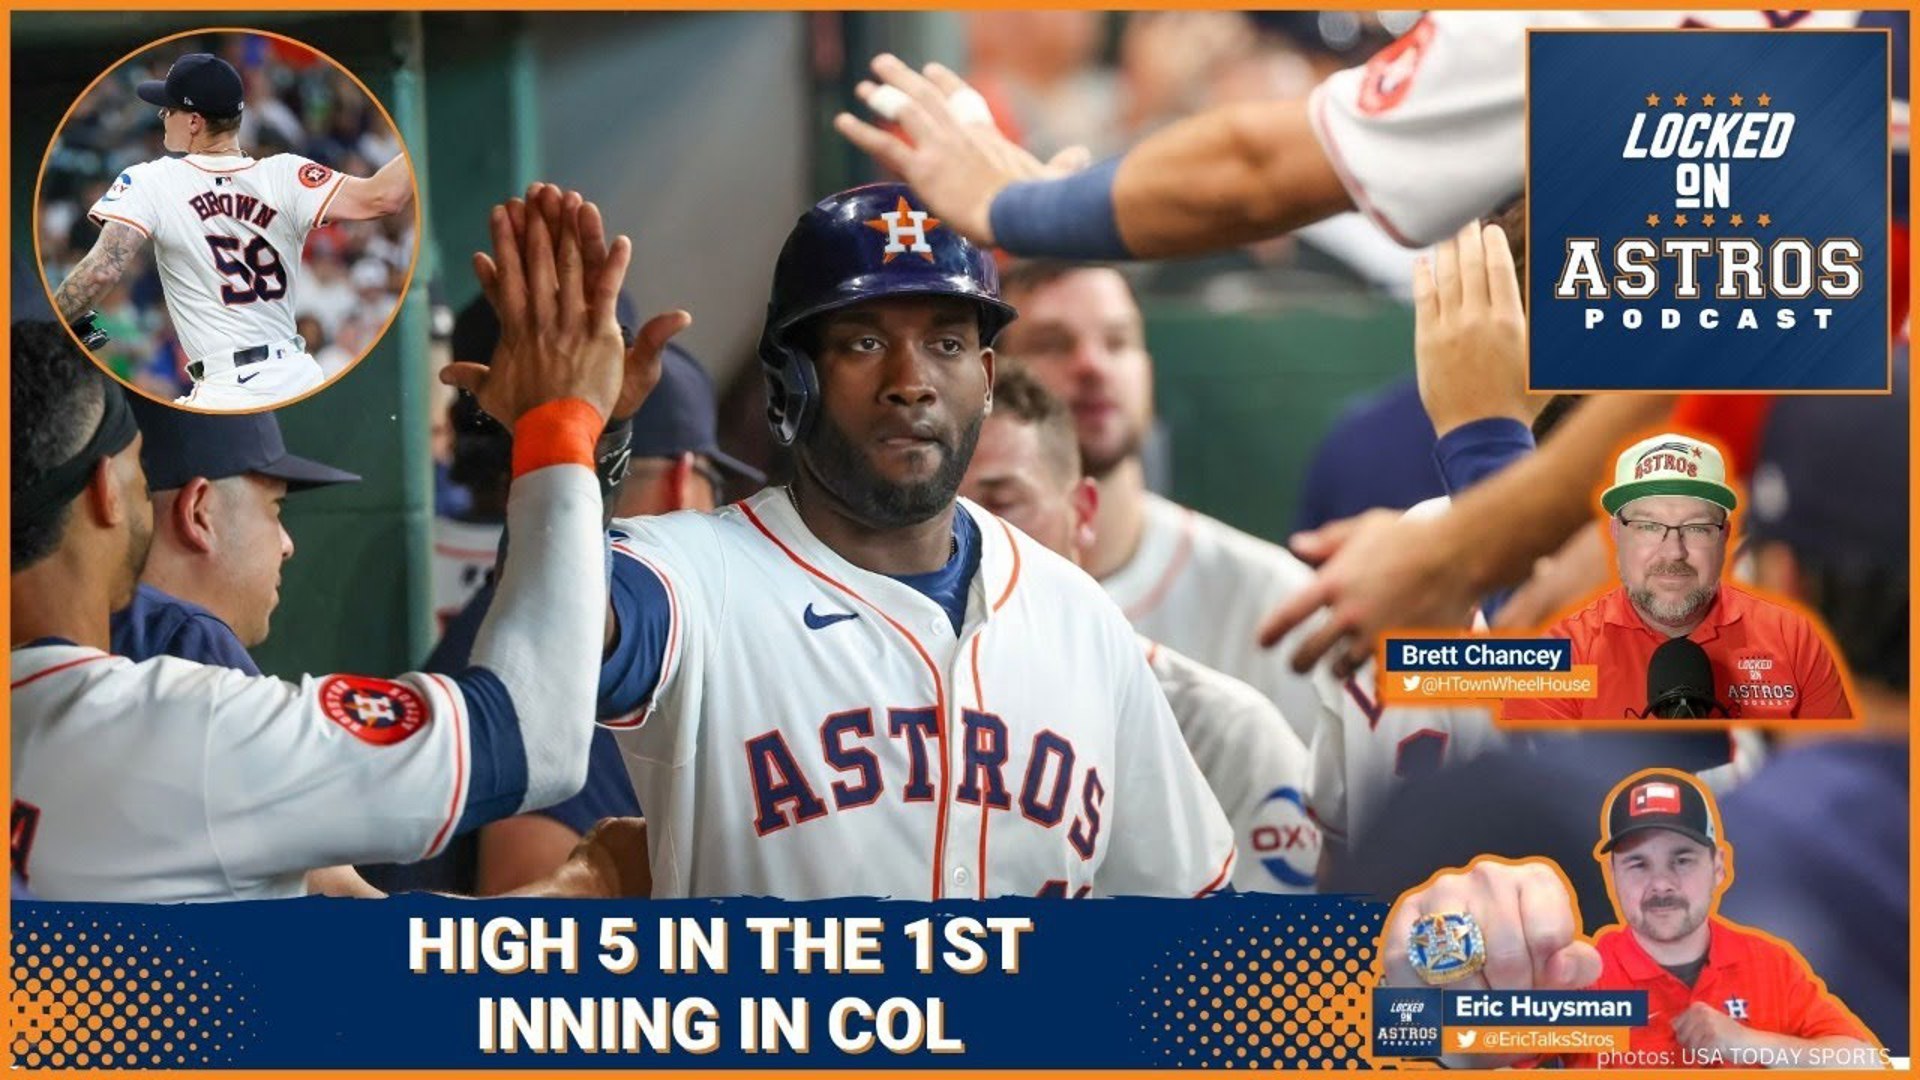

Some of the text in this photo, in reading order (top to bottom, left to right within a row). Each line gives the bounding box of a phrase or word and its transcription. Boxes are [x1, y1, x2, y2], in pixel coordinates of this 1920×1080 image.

[188, 190, 278, 229] BROWN
[881, 211, 932, 253] H
[204, 233, 287, 305] 58
[1634, 453, 1698, 480] ASTROS
[352, 693, 395, 722] H
[1728, 684, 1795, 699] ASTROS
[744, 706, 1106, 862] ASTROS
[1724, 998, 1749, 1019] H
